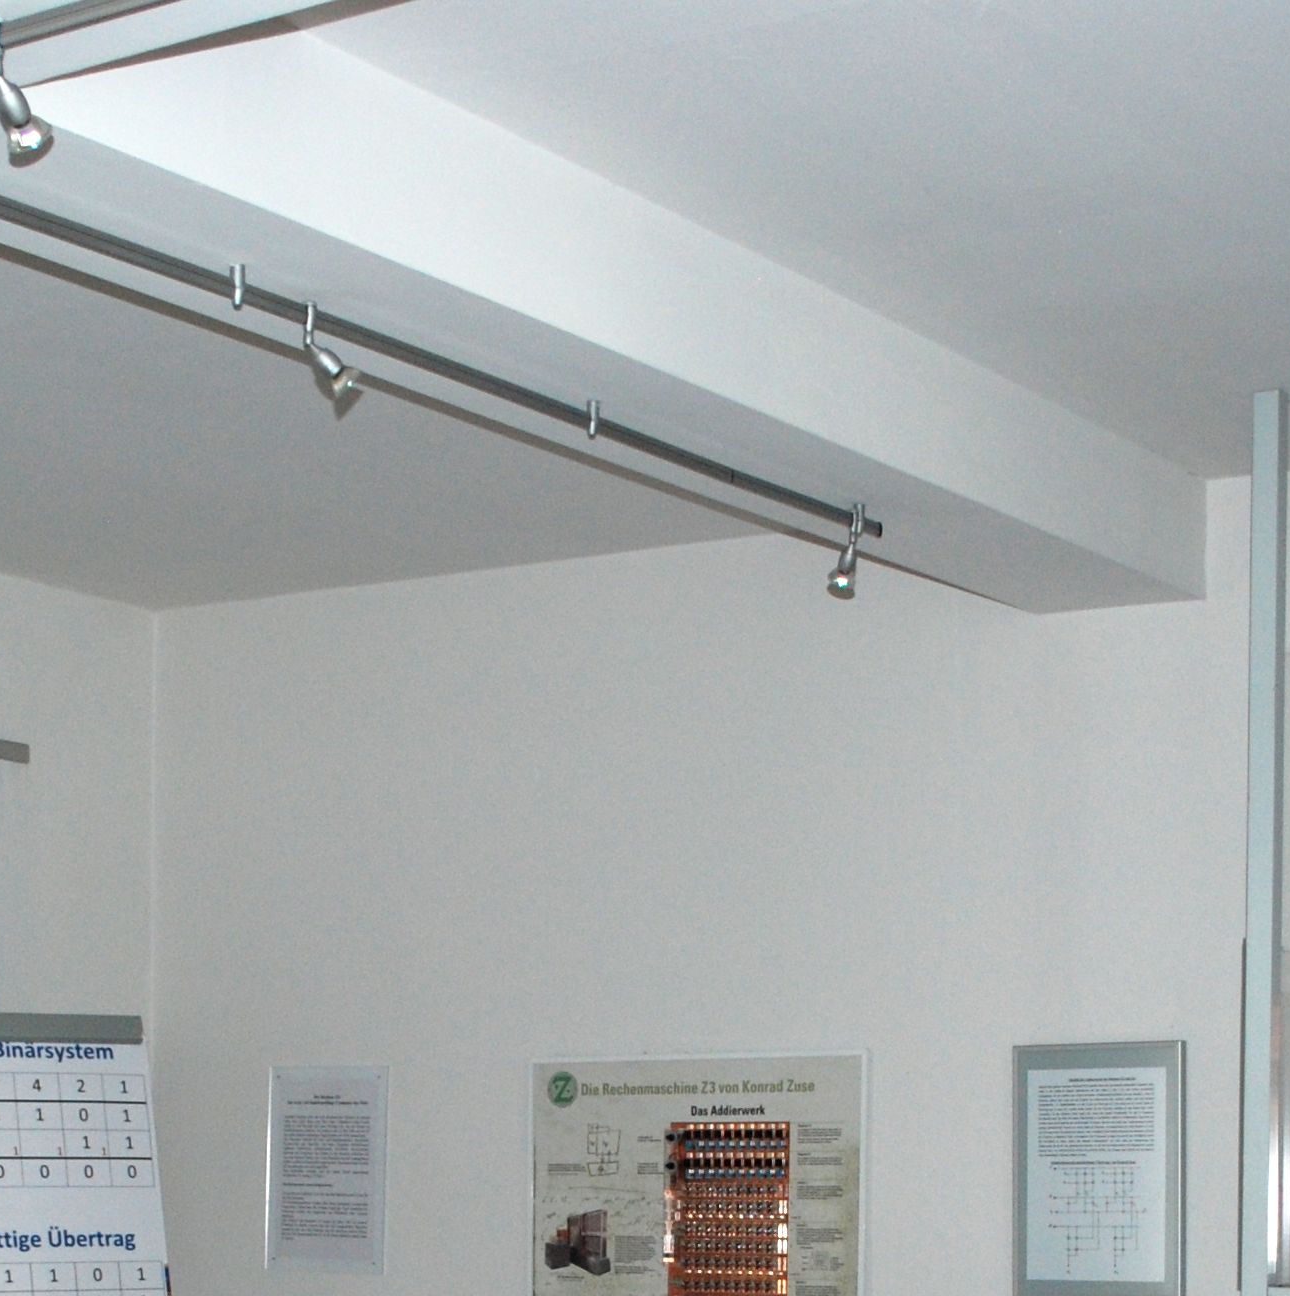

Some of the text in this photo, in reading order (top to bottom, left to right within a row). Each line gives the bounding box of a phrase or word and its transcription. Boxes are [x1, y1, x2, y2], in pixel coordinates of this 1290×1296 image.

[32, 1079, 42, 1092] 4
[77, 1079, 86, 1093] 2
[120, 1081, 128, 1094] 1
[581, 1079, 815, 1096] Die Rechenmaschine Z3 von Konrad Zuse
[36, 1109, 44, 1122] 1
[79, 1108, 89, 1122] 0
[123, 1109, 131, 1123] 1
[691, 1104, 766, 1117] Das Addierwerk
[82, 1136, 90, 1150] 1
[125, 1136, 133, 1150] 1
[40, 1165, 50, 1179] 0
[84, 1165, 94, 1179] 0
[127, 1165, 137, 1179] 0
[48, 1227, 136, 1251] Übertrag
[5, 1269, 13, 1283] 1
[50, 1269, 58, 1282] 1
[93, 1268, 103, 1282] 0
[138, 1267, 146, 1281] 1
